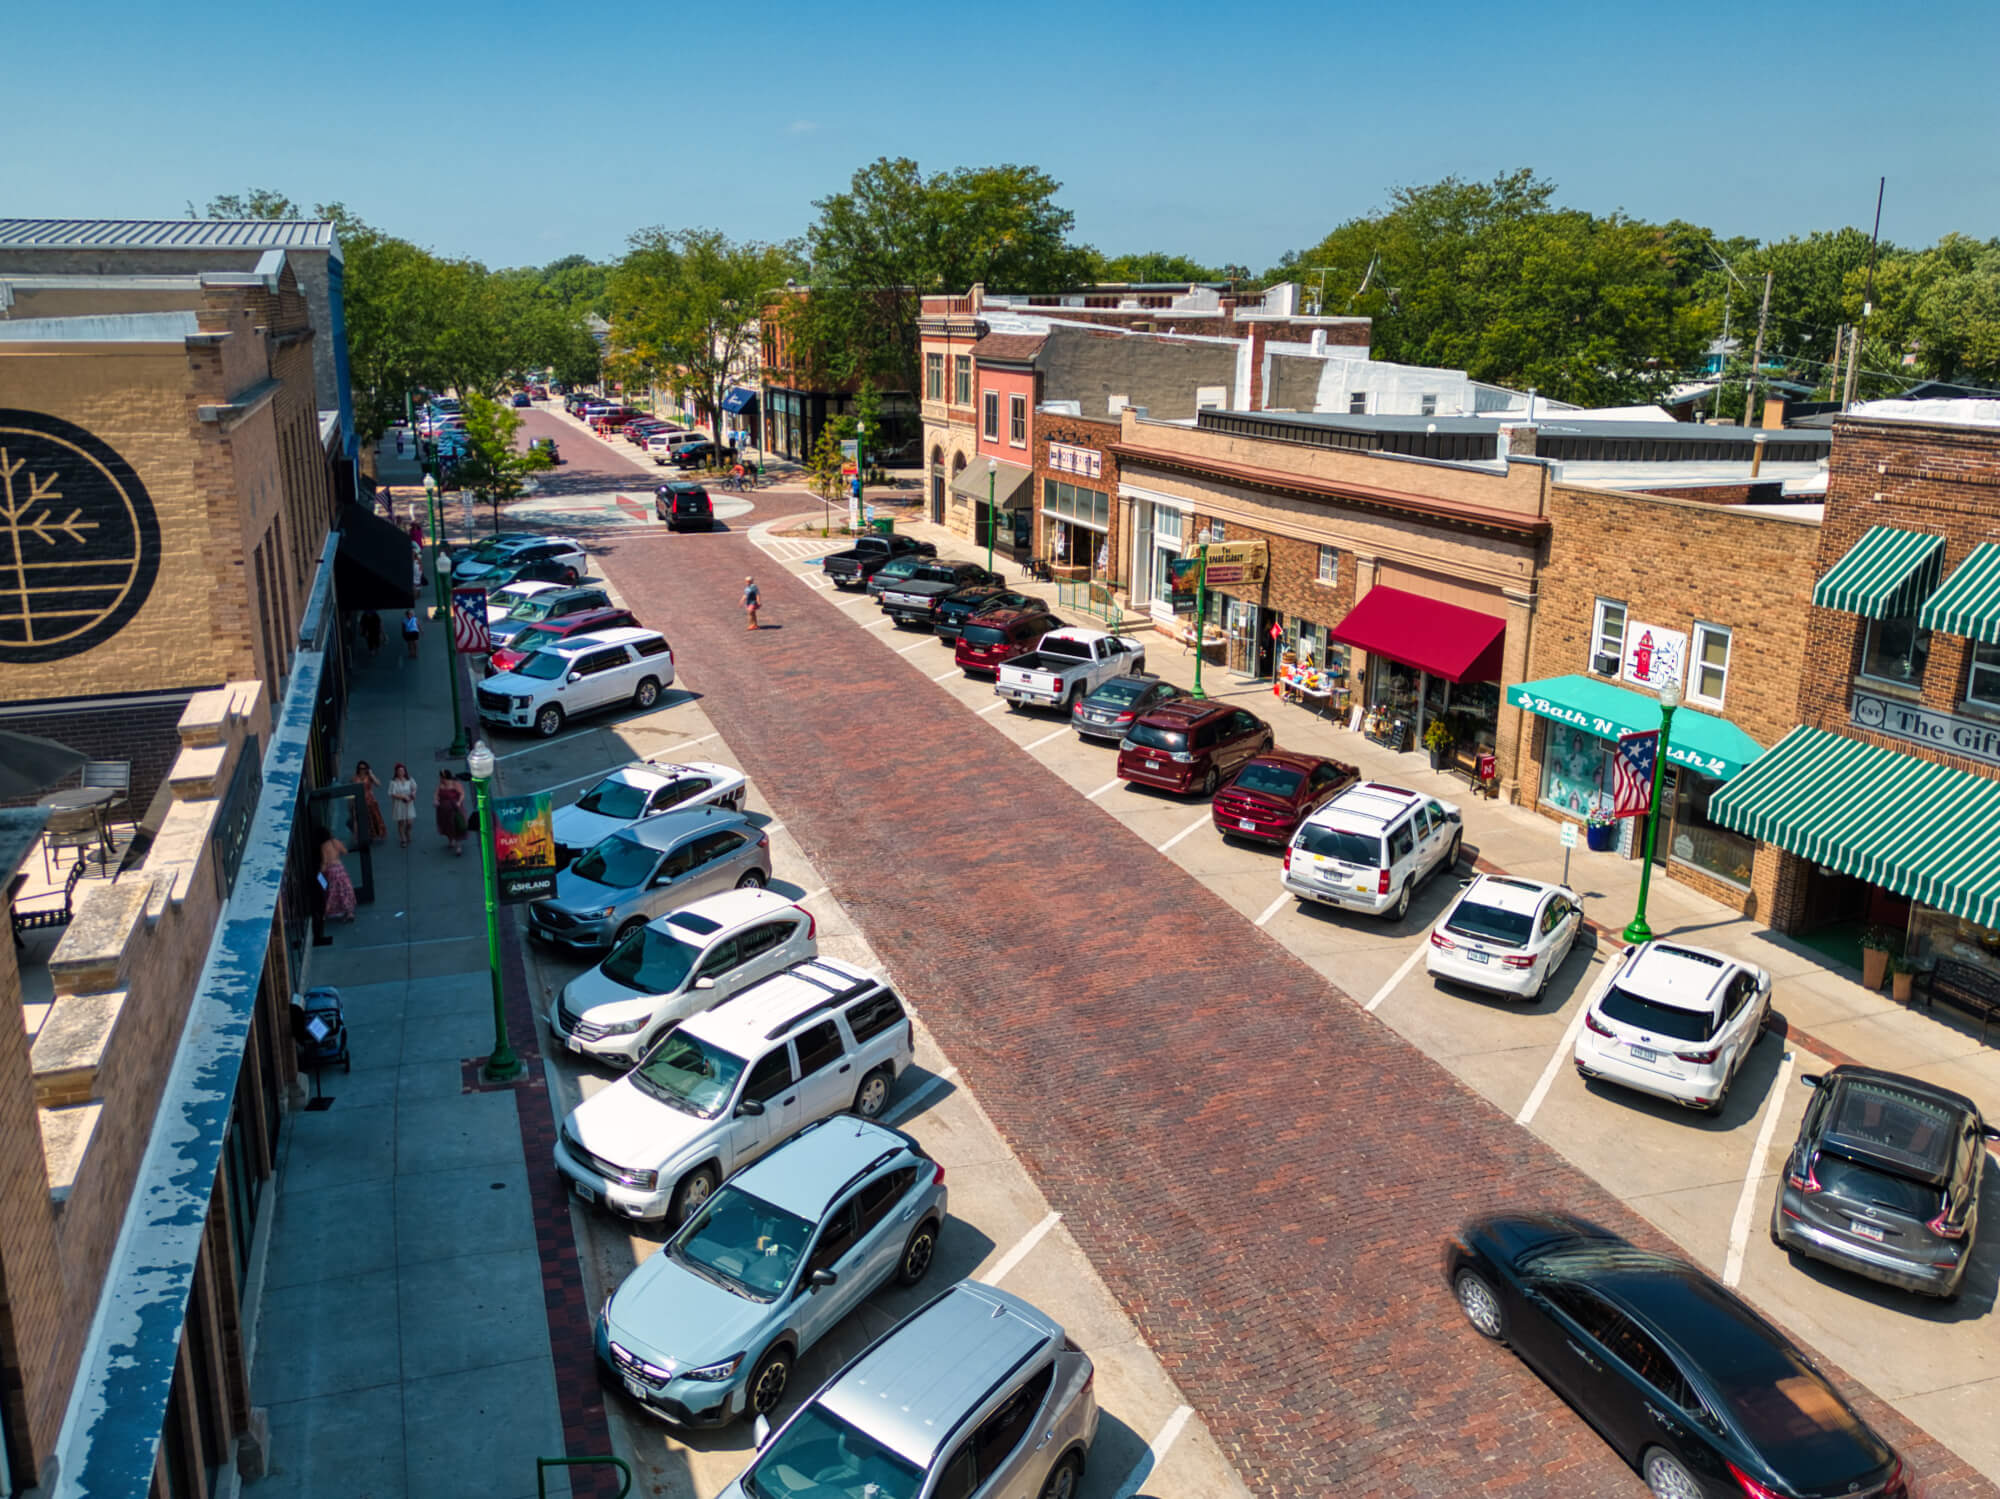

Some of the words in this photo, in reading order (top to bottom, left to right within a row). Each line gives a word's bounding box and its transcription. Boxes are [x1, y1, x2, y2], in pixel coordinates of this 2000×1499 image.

[1535, 698, 1588, 726] Bath
[1593, 719, 1613, 735] N
[1861, 705, 1880, 718] EST
[1896, 710, 1945, 740] The
[502, 807, 523, 816] SHOP
[500, 838, 519, 846] PLAY
[511, 880, 550, 891] ASHLAND
